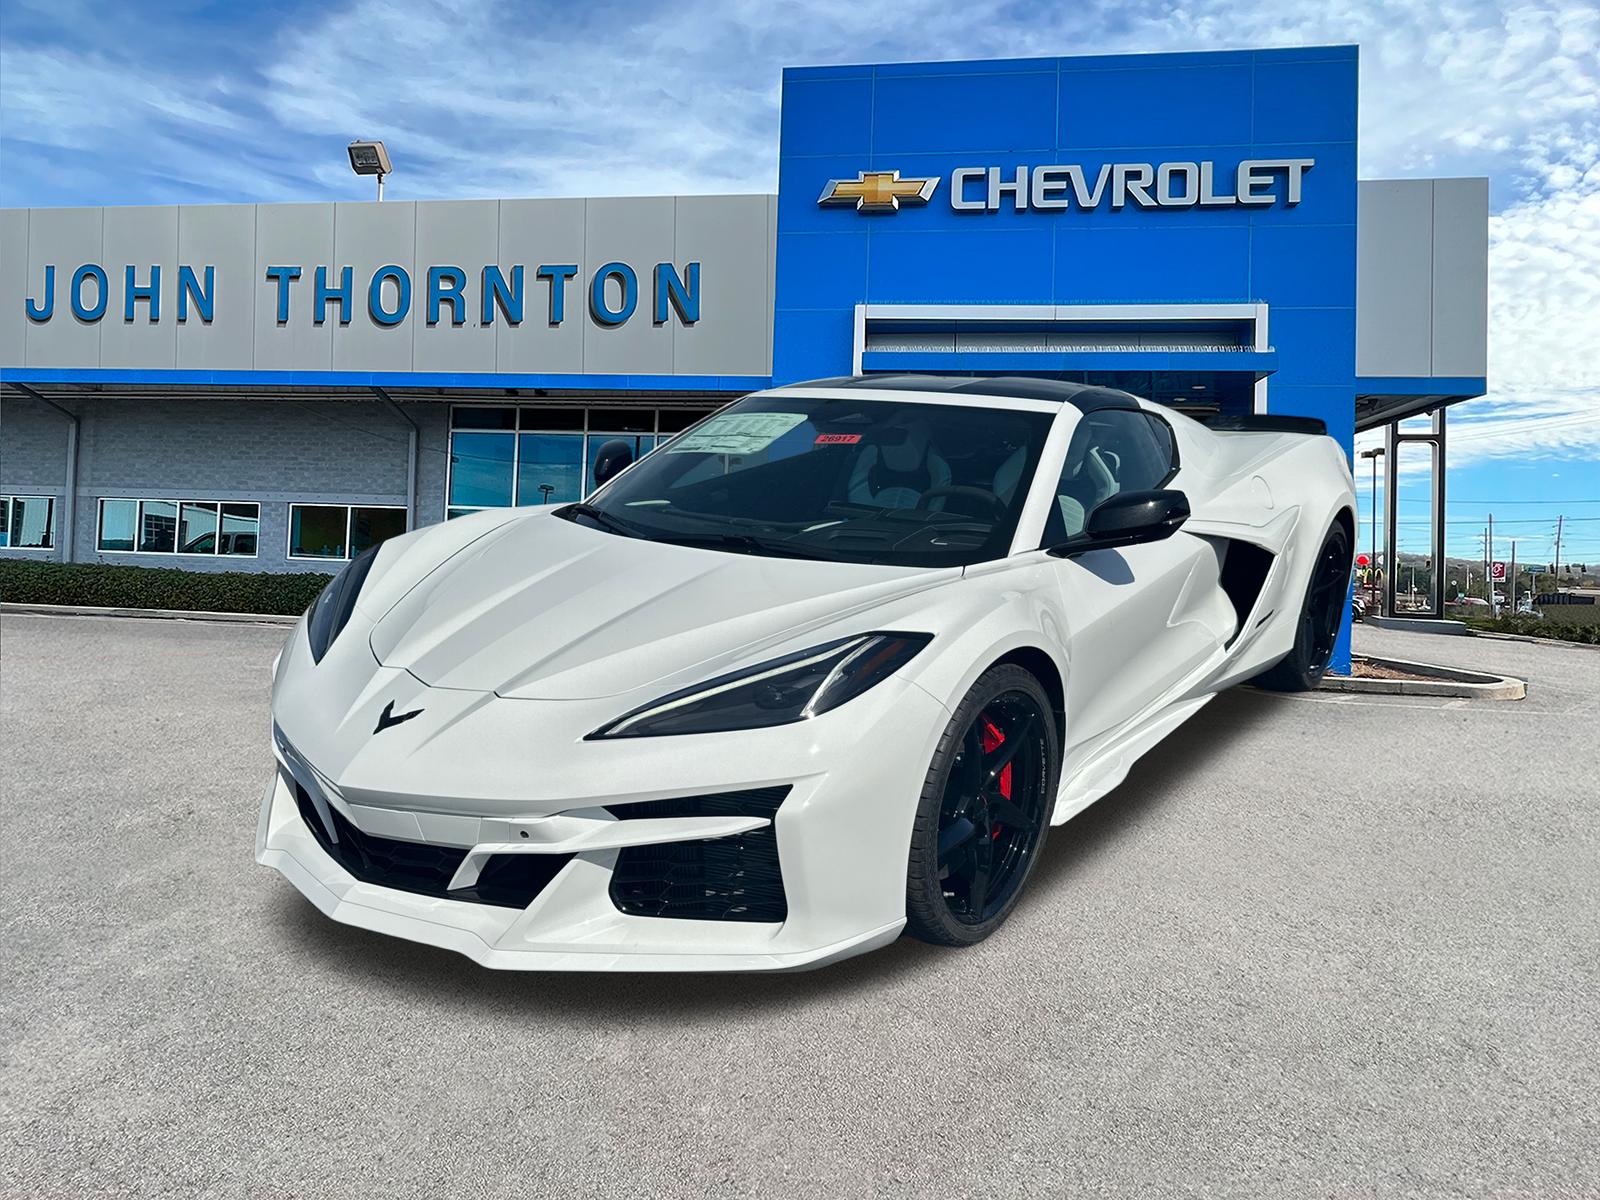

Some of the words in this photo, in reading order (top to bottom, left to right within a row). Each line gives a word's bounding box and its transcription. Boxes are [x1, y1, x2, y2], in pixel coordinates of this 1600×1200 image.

[949, 158, 1316, 211] CHEVROLET
[25, 264, 215, 322] JOHN
[266, 262, 702, 326] THORNTON
[820, 434, 856, 443] 26917
